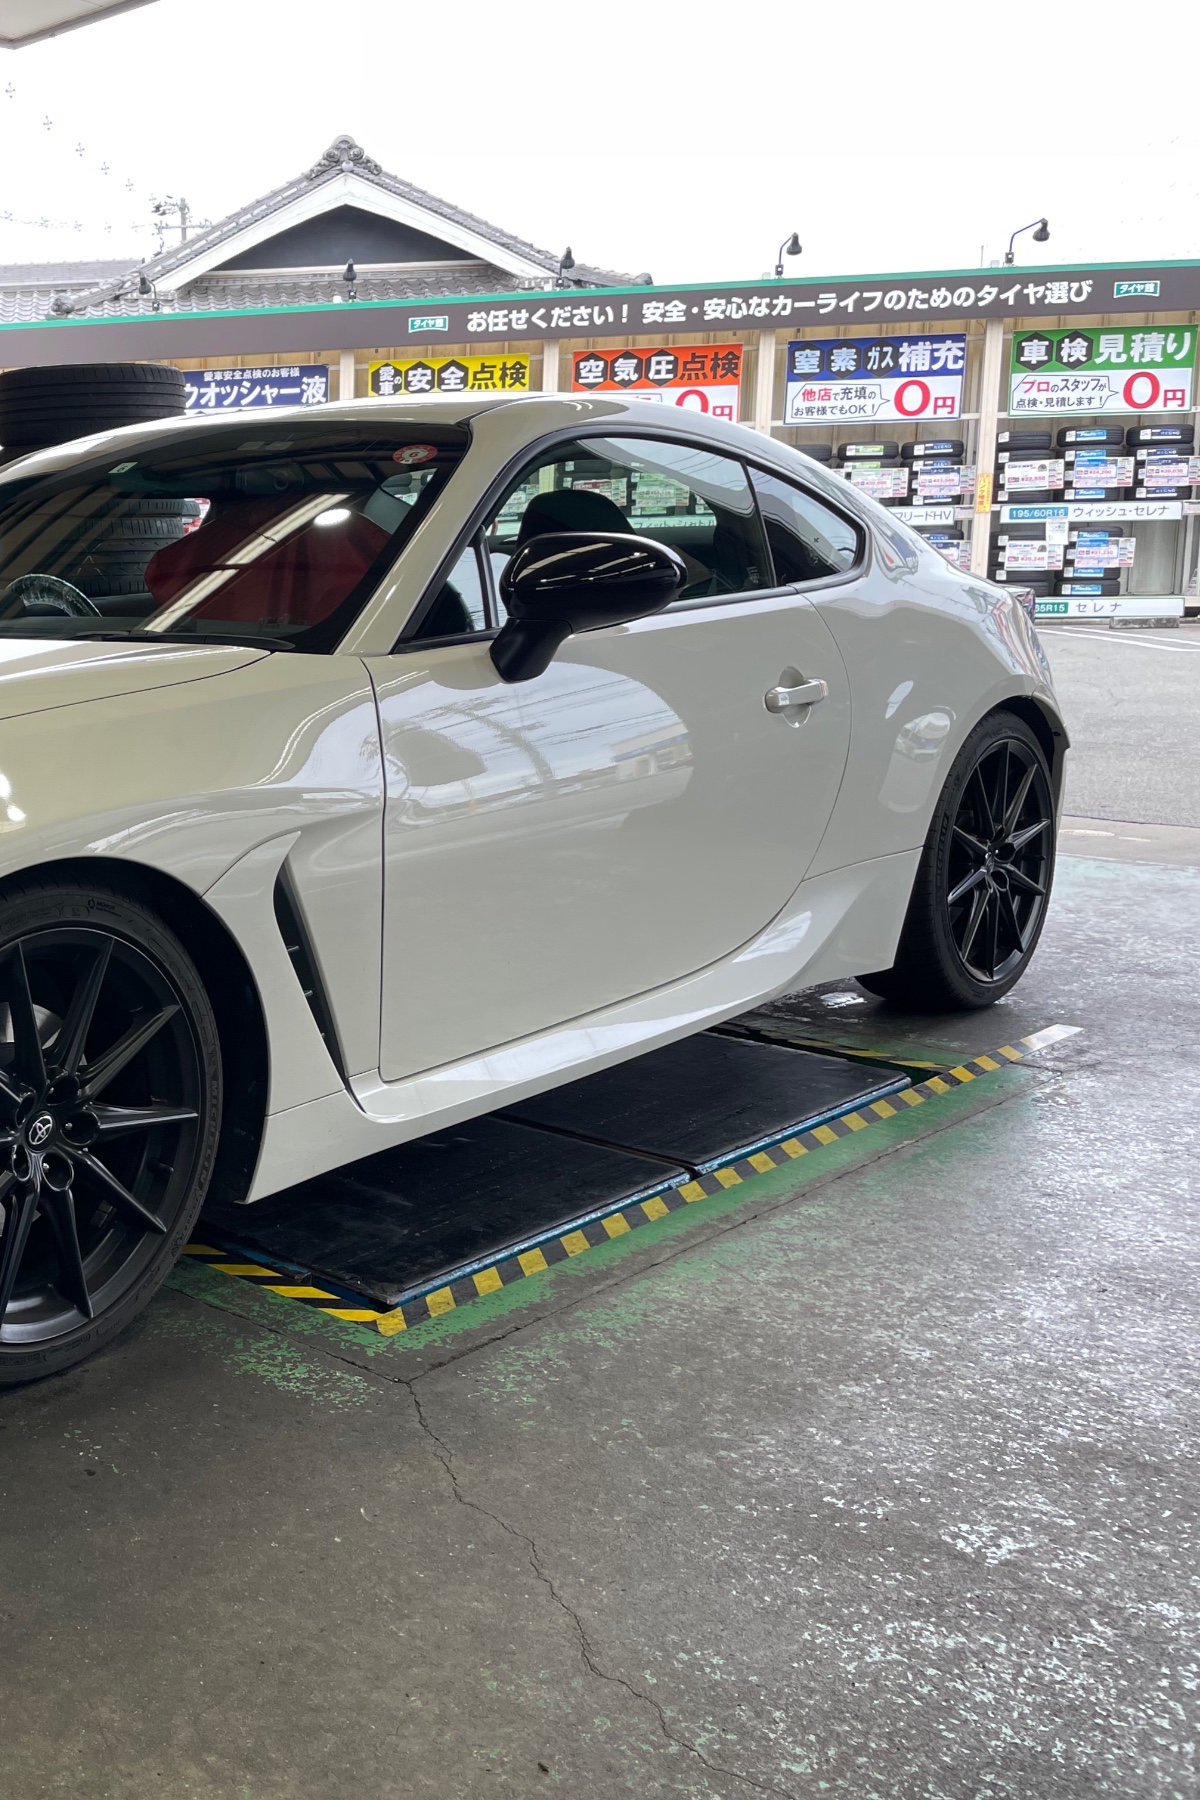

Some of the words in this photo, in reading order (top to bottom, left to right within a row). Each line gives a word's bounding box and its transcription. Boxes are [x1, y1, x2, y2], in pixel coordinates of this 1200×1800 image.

[1020, 332, 1191, 364] 車検見積り
[793, 340, 965, 374] 窒素ガス補充
[204, 367, 300, 381] 愛車安全点検のお客様
[578, 351, 740, 384] 空気圧点検
[1022, 378, 1106, 393] プロのスタッフが
[802, 386, 876, 402] 他店で充填の
[1012, 508, 1065, 517] 195/60R16
[1073, 506, 1169, 517] ウィッシュ・セレナ
